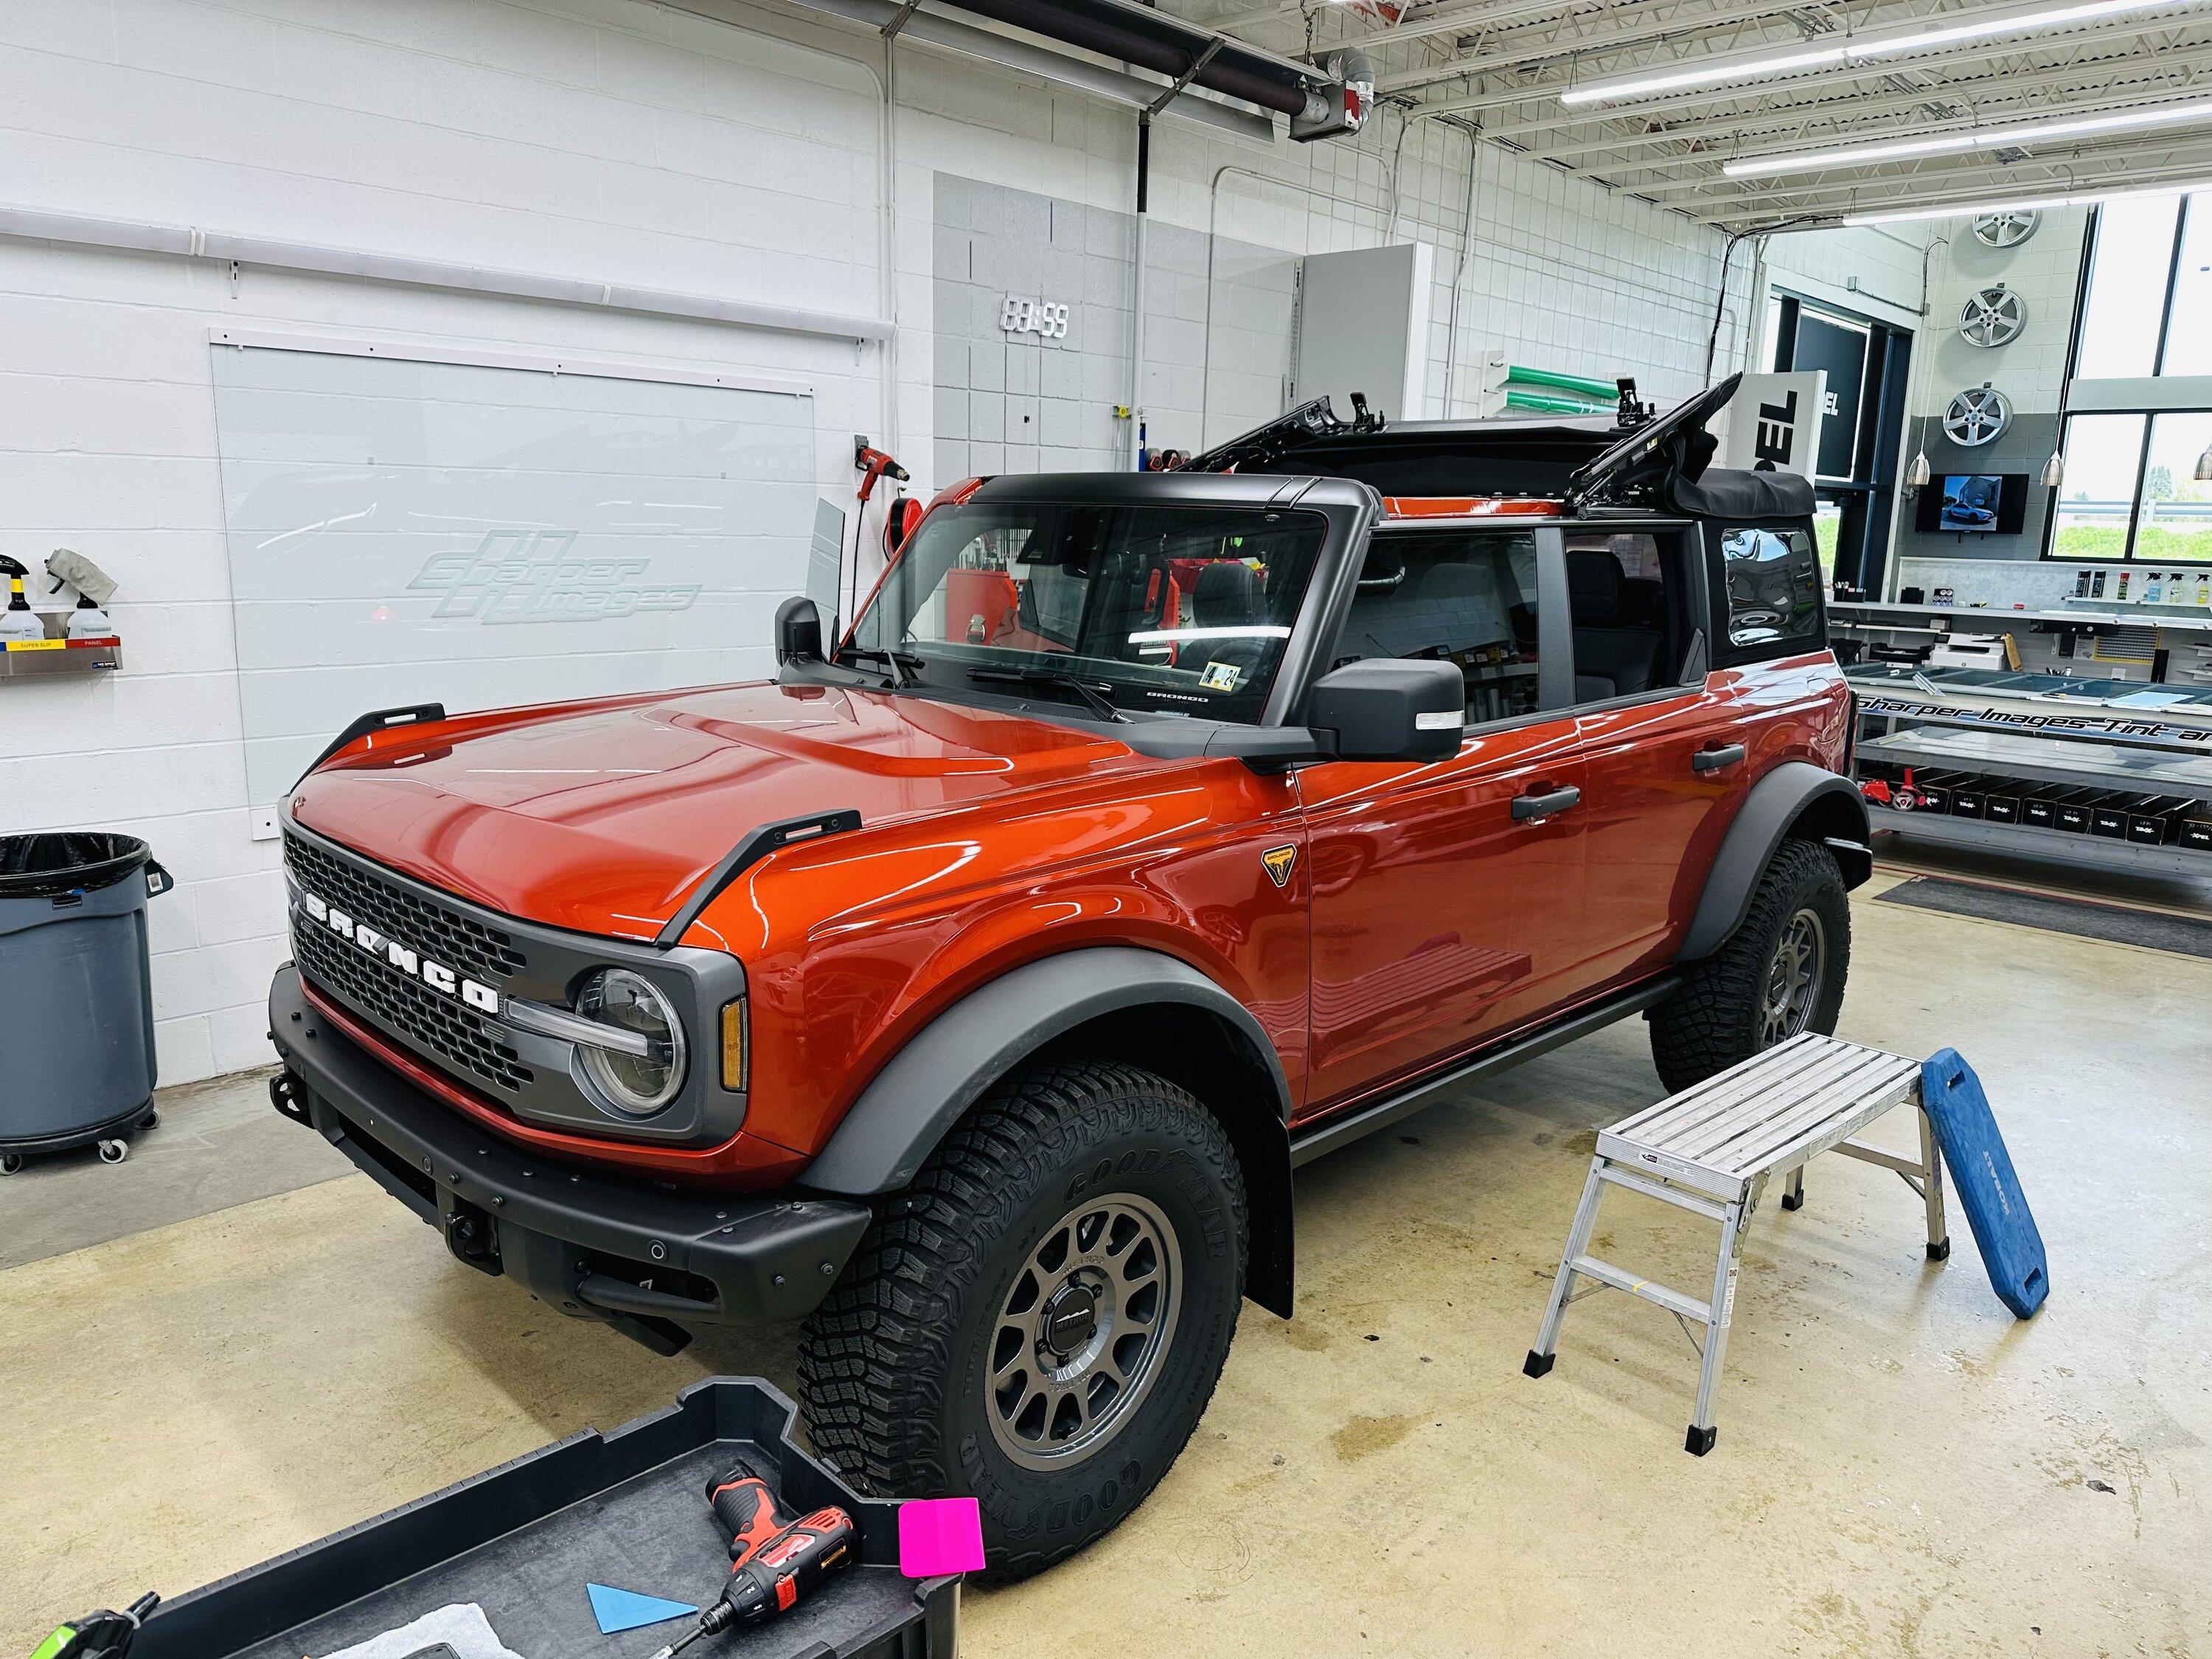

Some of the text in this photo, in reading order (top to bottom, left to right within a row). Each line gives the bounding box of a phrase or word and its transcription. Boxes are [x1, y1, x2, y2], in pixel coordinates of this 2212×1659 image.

[414, 553, 649, 588] Sharper
[532, 587, 699, 611] Images
[1224, 669, 1238, 686] 24
[1147, 692, 1209, 703] BRONCO
[1858, 696, 1973, 717] Sharper
[1978, 708, 2091, 729] Images
[2104, 717, 2170, 737] Tint
[306, 893, 498, 1014] BRONCO
[1983, 1150, 2010, 1216] KOBALT
[1062, 1255, 1105, 1276] METHOD
